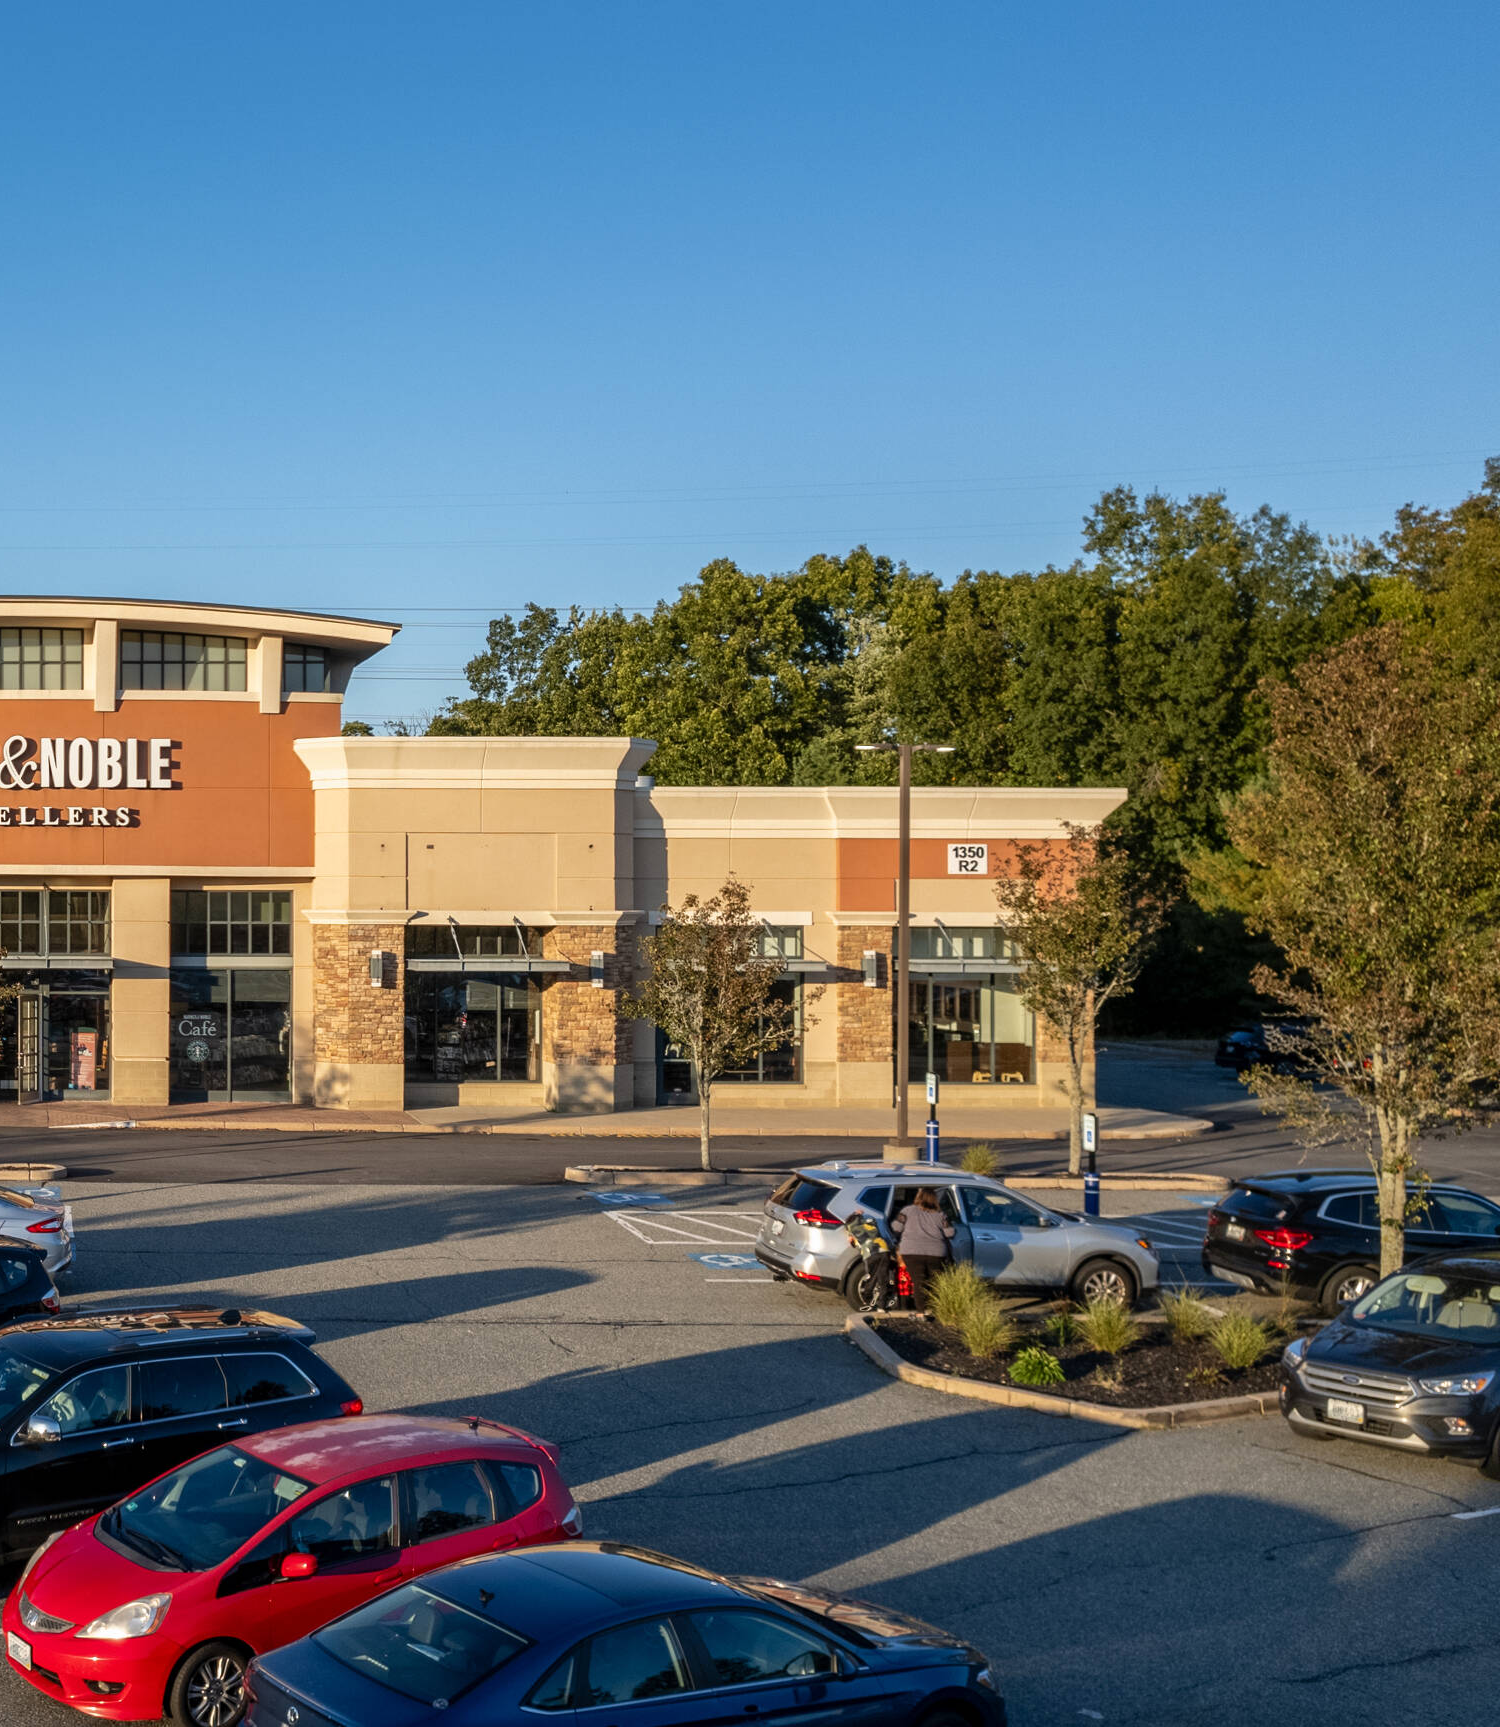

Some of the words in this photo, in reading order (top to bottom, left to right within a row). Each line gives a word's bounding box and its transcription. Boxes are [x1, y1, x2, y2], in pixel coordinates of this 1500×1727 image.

[952, 846, 985, 858] 1350
[959, 860, 978, 872] R2
[178, 1020, 217, 1036] Café
